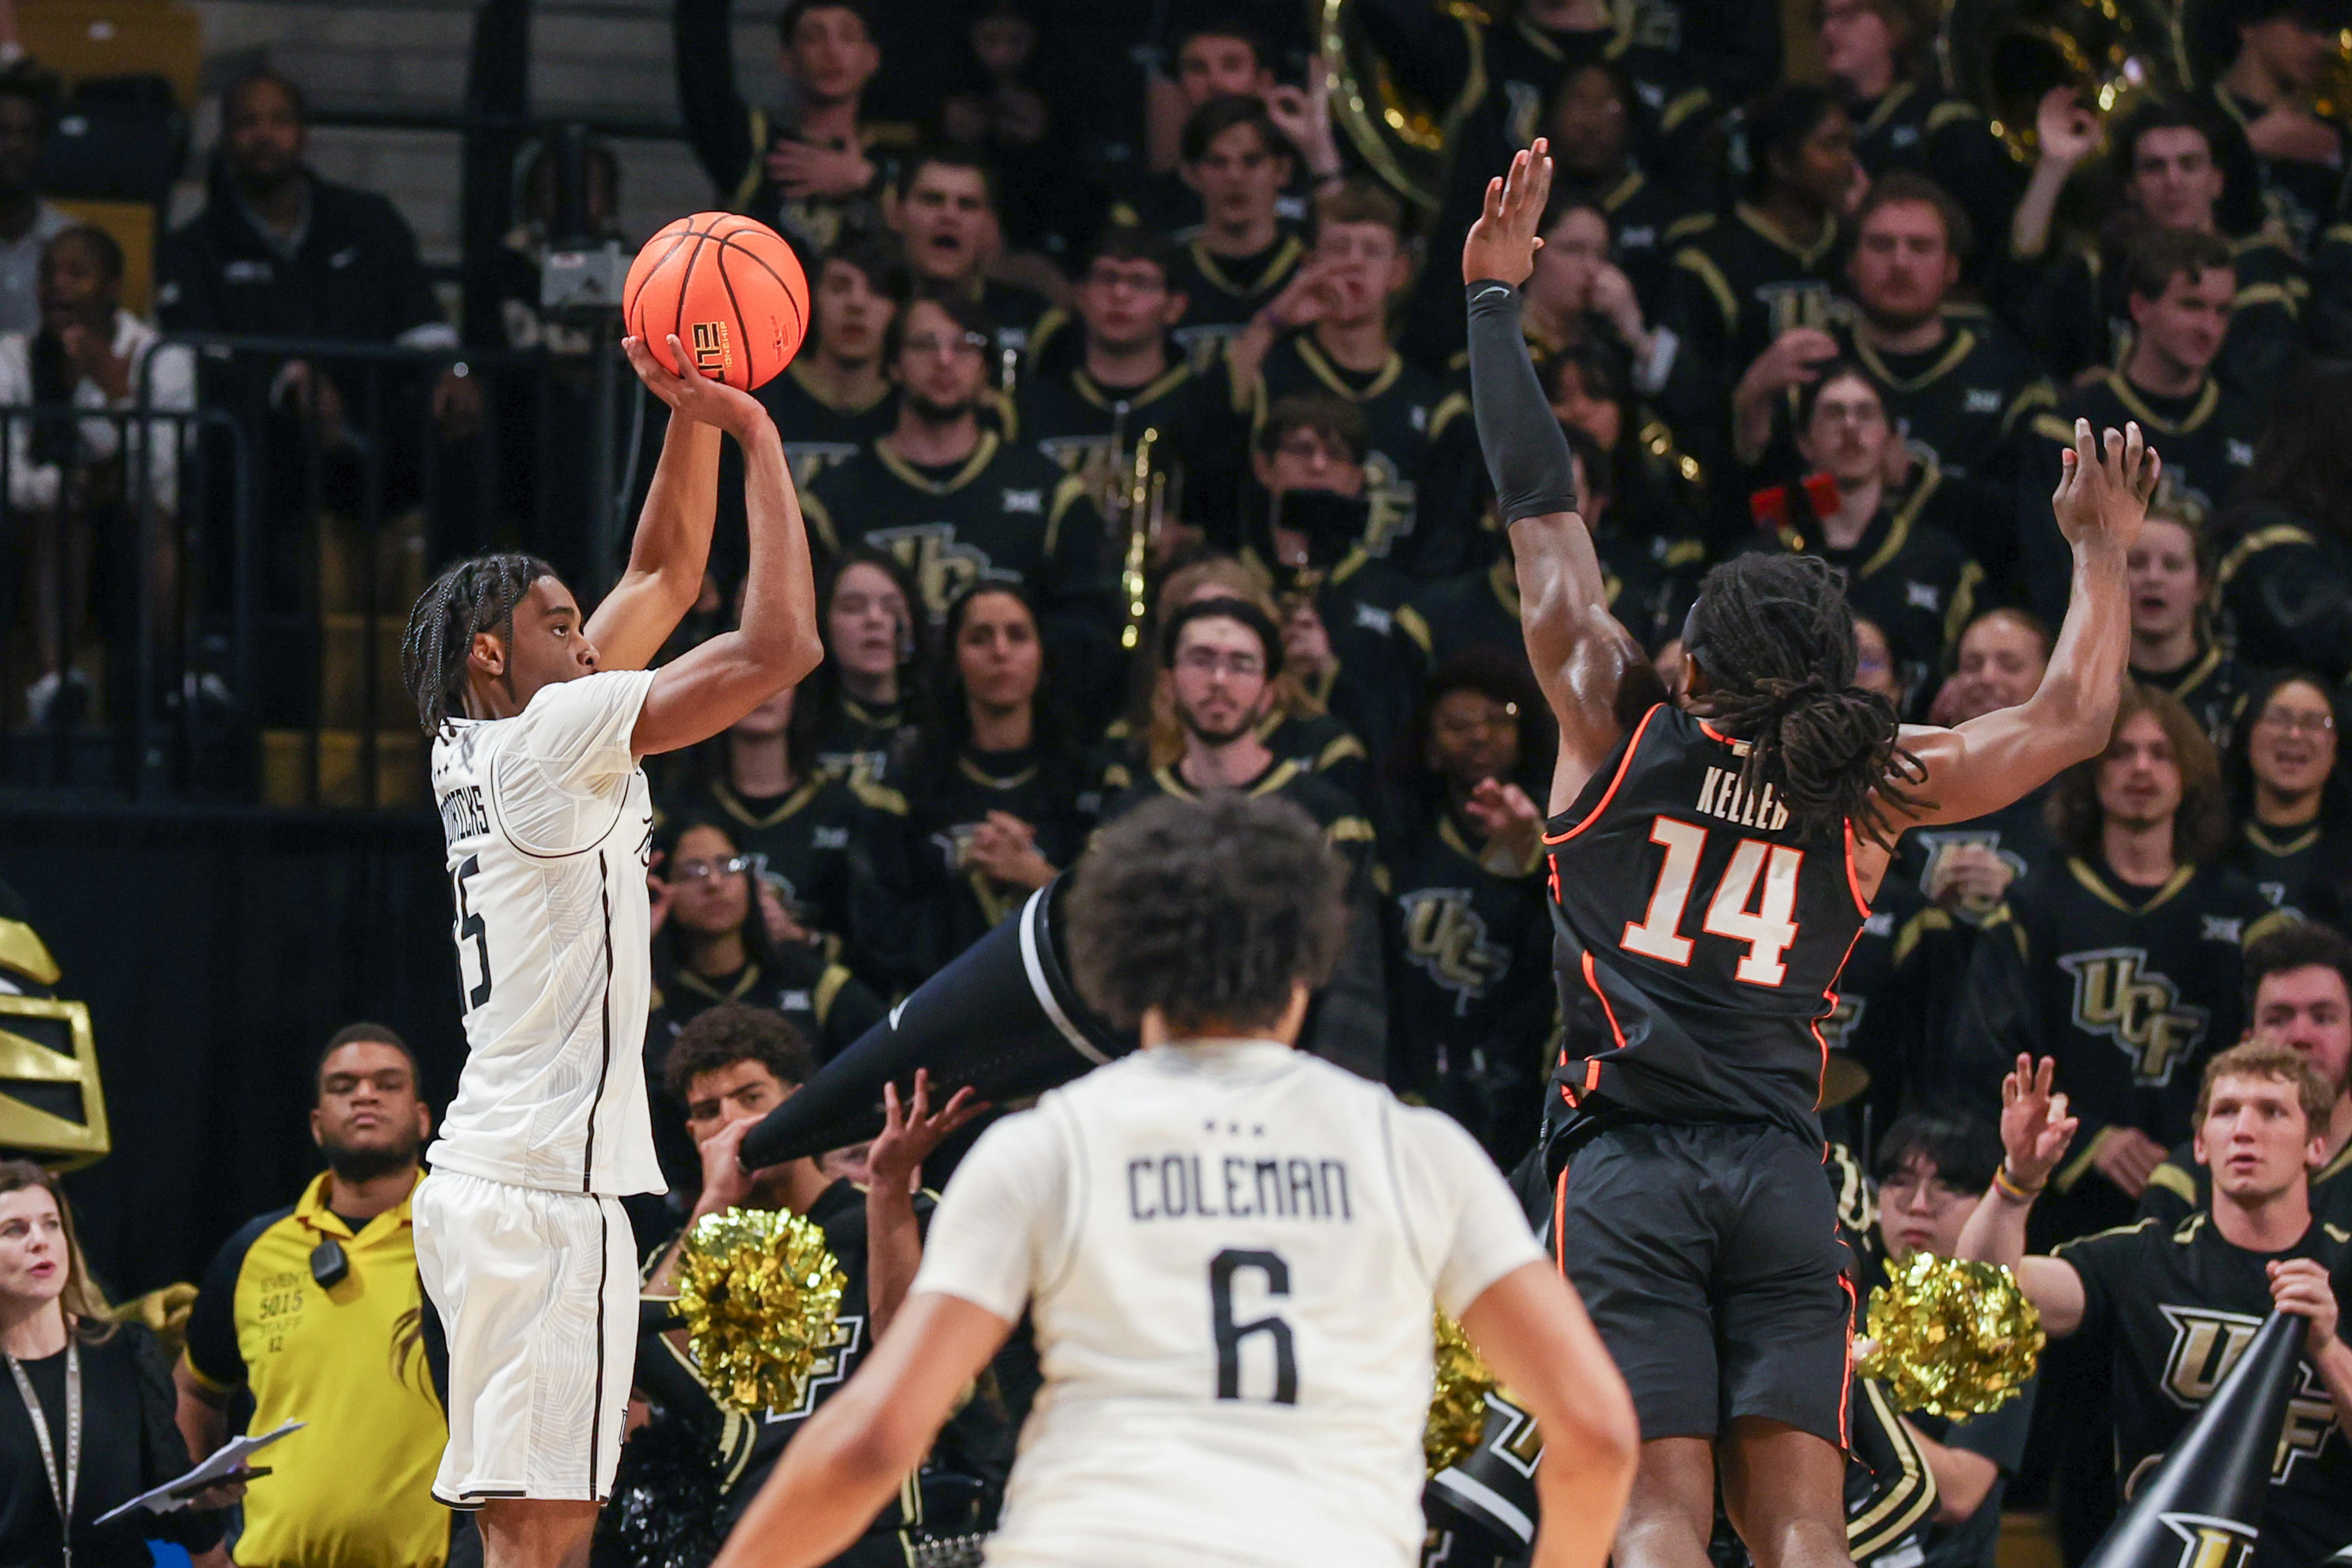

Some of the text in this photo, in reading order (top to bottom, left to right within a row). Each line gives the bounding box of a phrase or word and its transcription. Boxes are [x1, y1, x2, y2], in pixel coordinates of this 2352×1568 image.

[1619, 814, 1805, 988] 14
[2056, 946, 2211, 1088] UCF
[1127, 1151, 1353, 1222] COLEMAN
[1208, 1248, 1300, 1406] 6
[2157, 1303, 2340, 1486] UF
